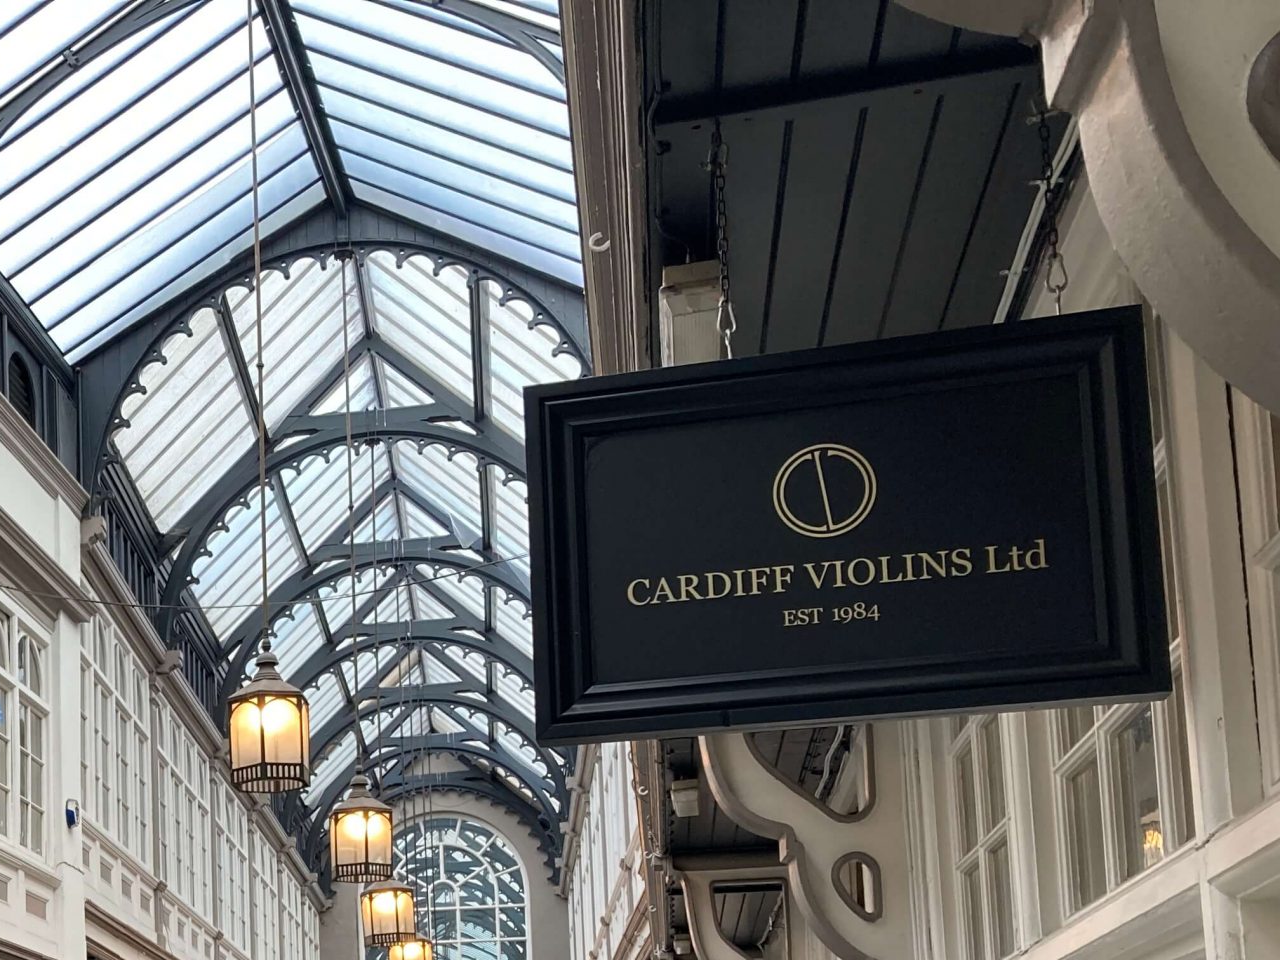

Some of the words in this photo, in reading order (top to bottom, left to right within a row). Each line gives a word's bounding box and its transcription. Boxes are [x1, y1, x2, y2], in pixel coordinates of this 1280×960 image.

[626, 564, 795, 607] CARDIFF
[803, 547, 973, 590] VIOLINS
[984, 538, 1050, 574] Ltd
[782, 607, 824, 627] EST
[831, 602, 881, 622] 1984
